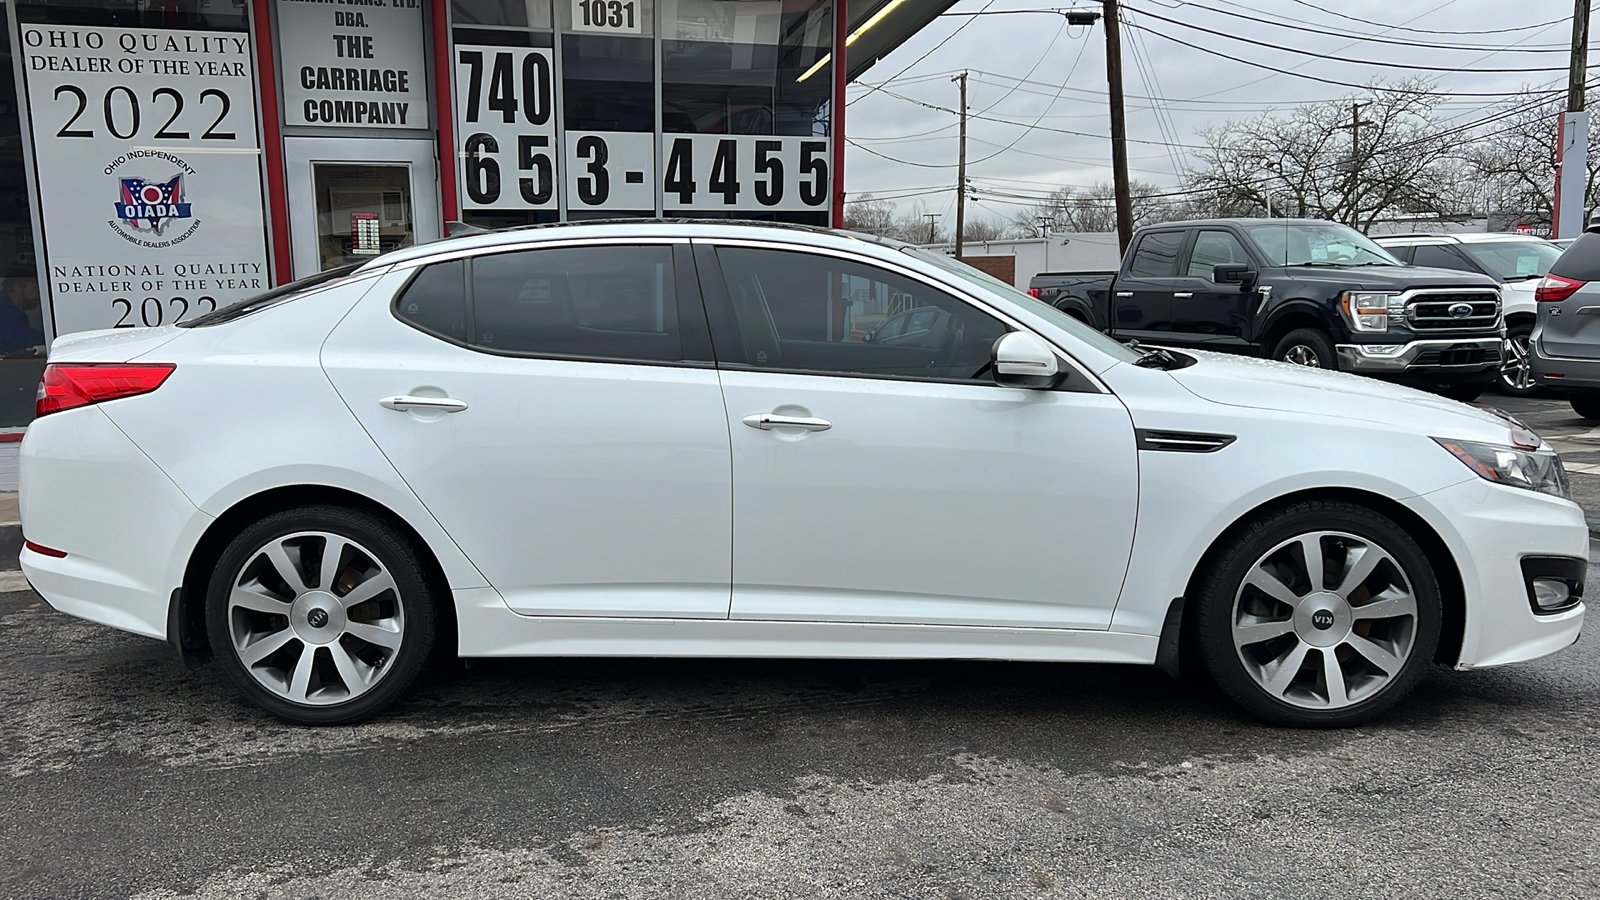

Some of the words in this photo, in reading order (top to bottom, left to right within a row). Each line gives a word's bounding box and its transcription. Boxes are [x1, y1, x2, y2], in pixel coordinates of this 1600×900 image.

[334, 11, 369, 28] DBA.
[578, 0, 635, 29] 1031
[24, 29, 104, 49] OHIO
[119, 33, 247, 55] QUALITY
[332, 34, 374, 59] THE
[30, 55, 113, 73] DEALER
[118, 58, 144, 74] OF
[149, 59, 190, 76] THE
[194, 61, 247, 77] YEAR
[300, 66, 410, 93] CARRIAGE
[459, 50, 551, 126] 740
[54, 84, 237, 140] 2022
[303, 99, 409, 125] COMPANY
[103, 156, 126, 175] OHIO
[126, 149, 196, 175] INDEPENDENT
[125, 204, 179, 218] OIADA
[107, 219, 142, 246] AUTOMOBILE
[143, 240, 171, 248] DEALERS
[171, 218, 202, 246] ASSOCIATION
[54, 264, 165, 278] NATIONAL
[173, 263, 262, 276] QUALITY
[58, 281, 133, 293] DEALER
[141, 280, 164, 291] OF
[172, 279, 208, 291] THE
[215, 278, 261, 290] YEAR
[310, 610, 327, 627] KIA
[1313, 614, 1334, 625] KIA
